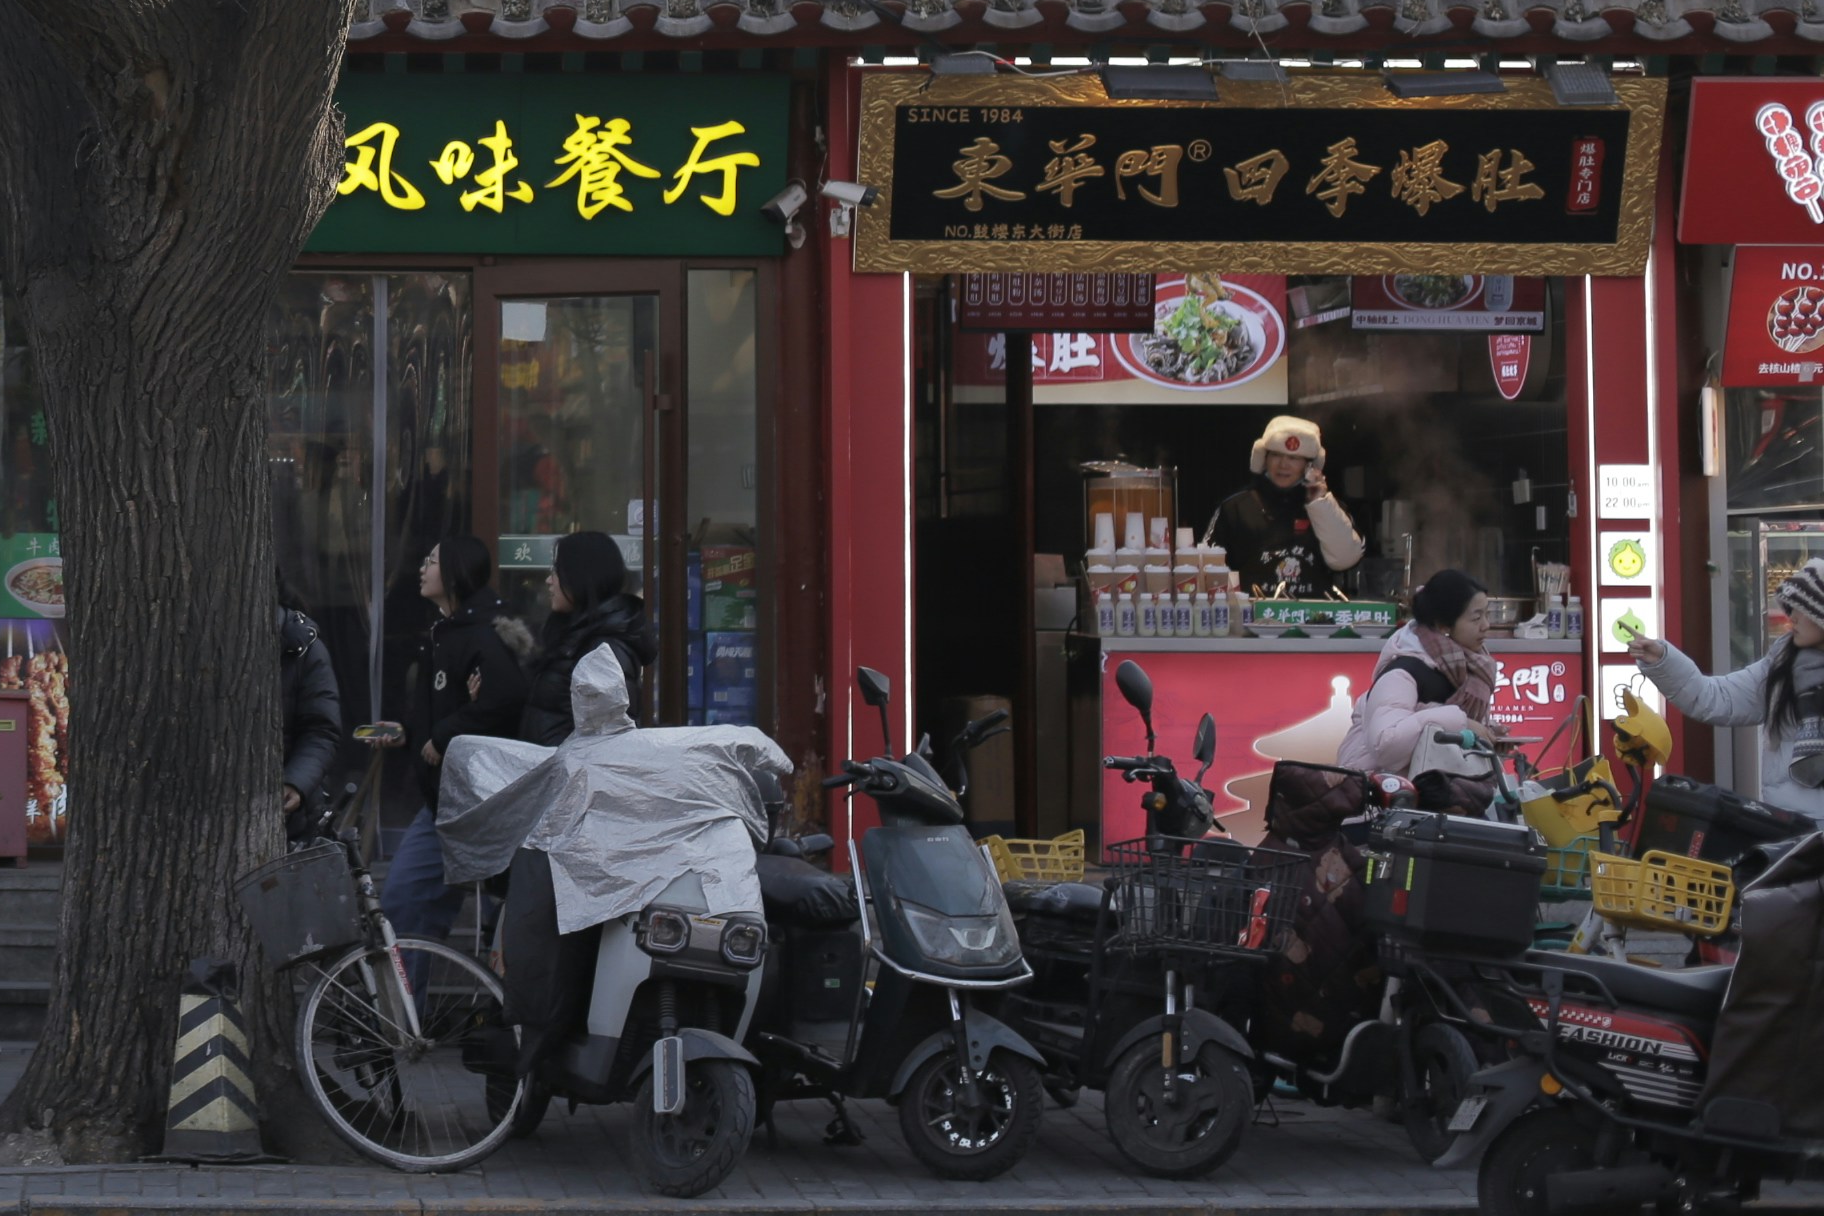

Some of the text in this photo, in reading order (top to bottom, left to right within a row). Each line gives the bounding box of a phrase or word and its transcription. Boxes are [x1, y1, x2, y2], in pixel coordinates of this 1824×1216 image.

[907, 108, 1024, 124] SINCE 1984
[335, 112, 761, 221] 风味餐厅
[1576, 142, 1597, 205] 爆肚专门店
